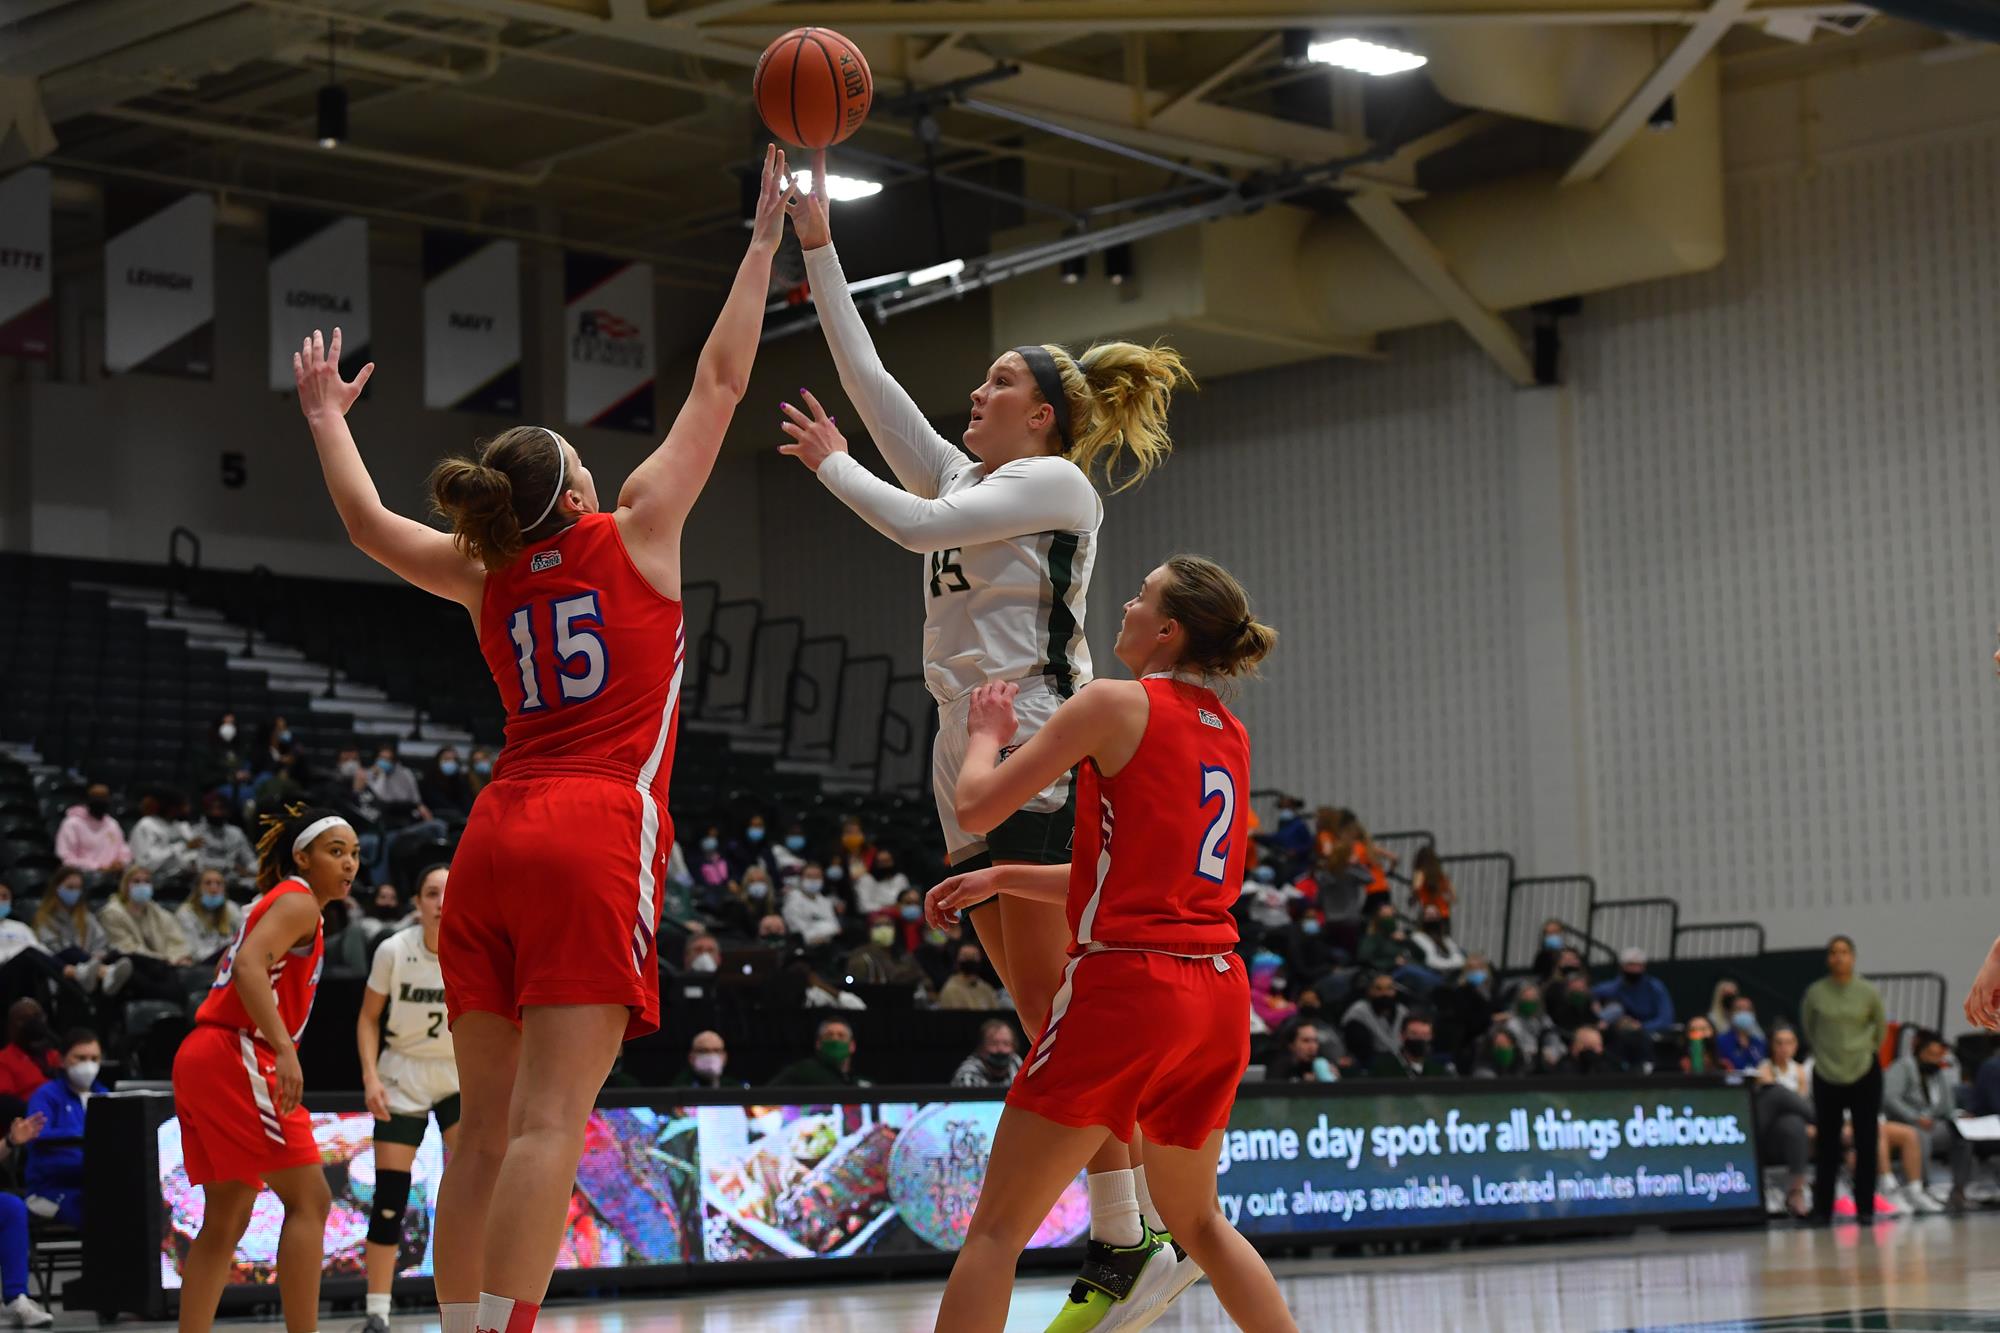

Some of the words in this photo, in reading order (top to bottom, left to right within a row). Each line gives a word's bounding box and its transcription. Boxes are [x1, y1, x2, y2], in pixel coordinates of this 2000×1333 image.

[126, 267, 194, 291] LEHIGH
[286, 289, 352, 313] LOYOLA
[448, 311, 495, 332] NAVY
[221, 451, 246, 489] 5
[508, 591, 609, 712] 15
[1194, 763, 1235, 884] 2
[428, 1012, 443, 1038] 2
[1307, 1113, 1364, 1170] day
[1371, 1118, 1442, 1168] spot
[1445, 1109, 1490, 1153] for
[1496, 1108, 1530, 1151] all
[1534, 1107, 1621, 1160] things
[1624, 1105, 1746, 1147] delicious.
[1247, 1188, 1288, 1216] out
[1292, 1180, 1367, 1222] always
[1370, 1175, 1470, 1209] available.
[1473, 1169, 1555, 1205] Located
[1558, 1171, 1636, 1200] minutes
[1637, 1165, 1683, 1197] from
[1683, 1162, 1751, 1203] Loyola.
